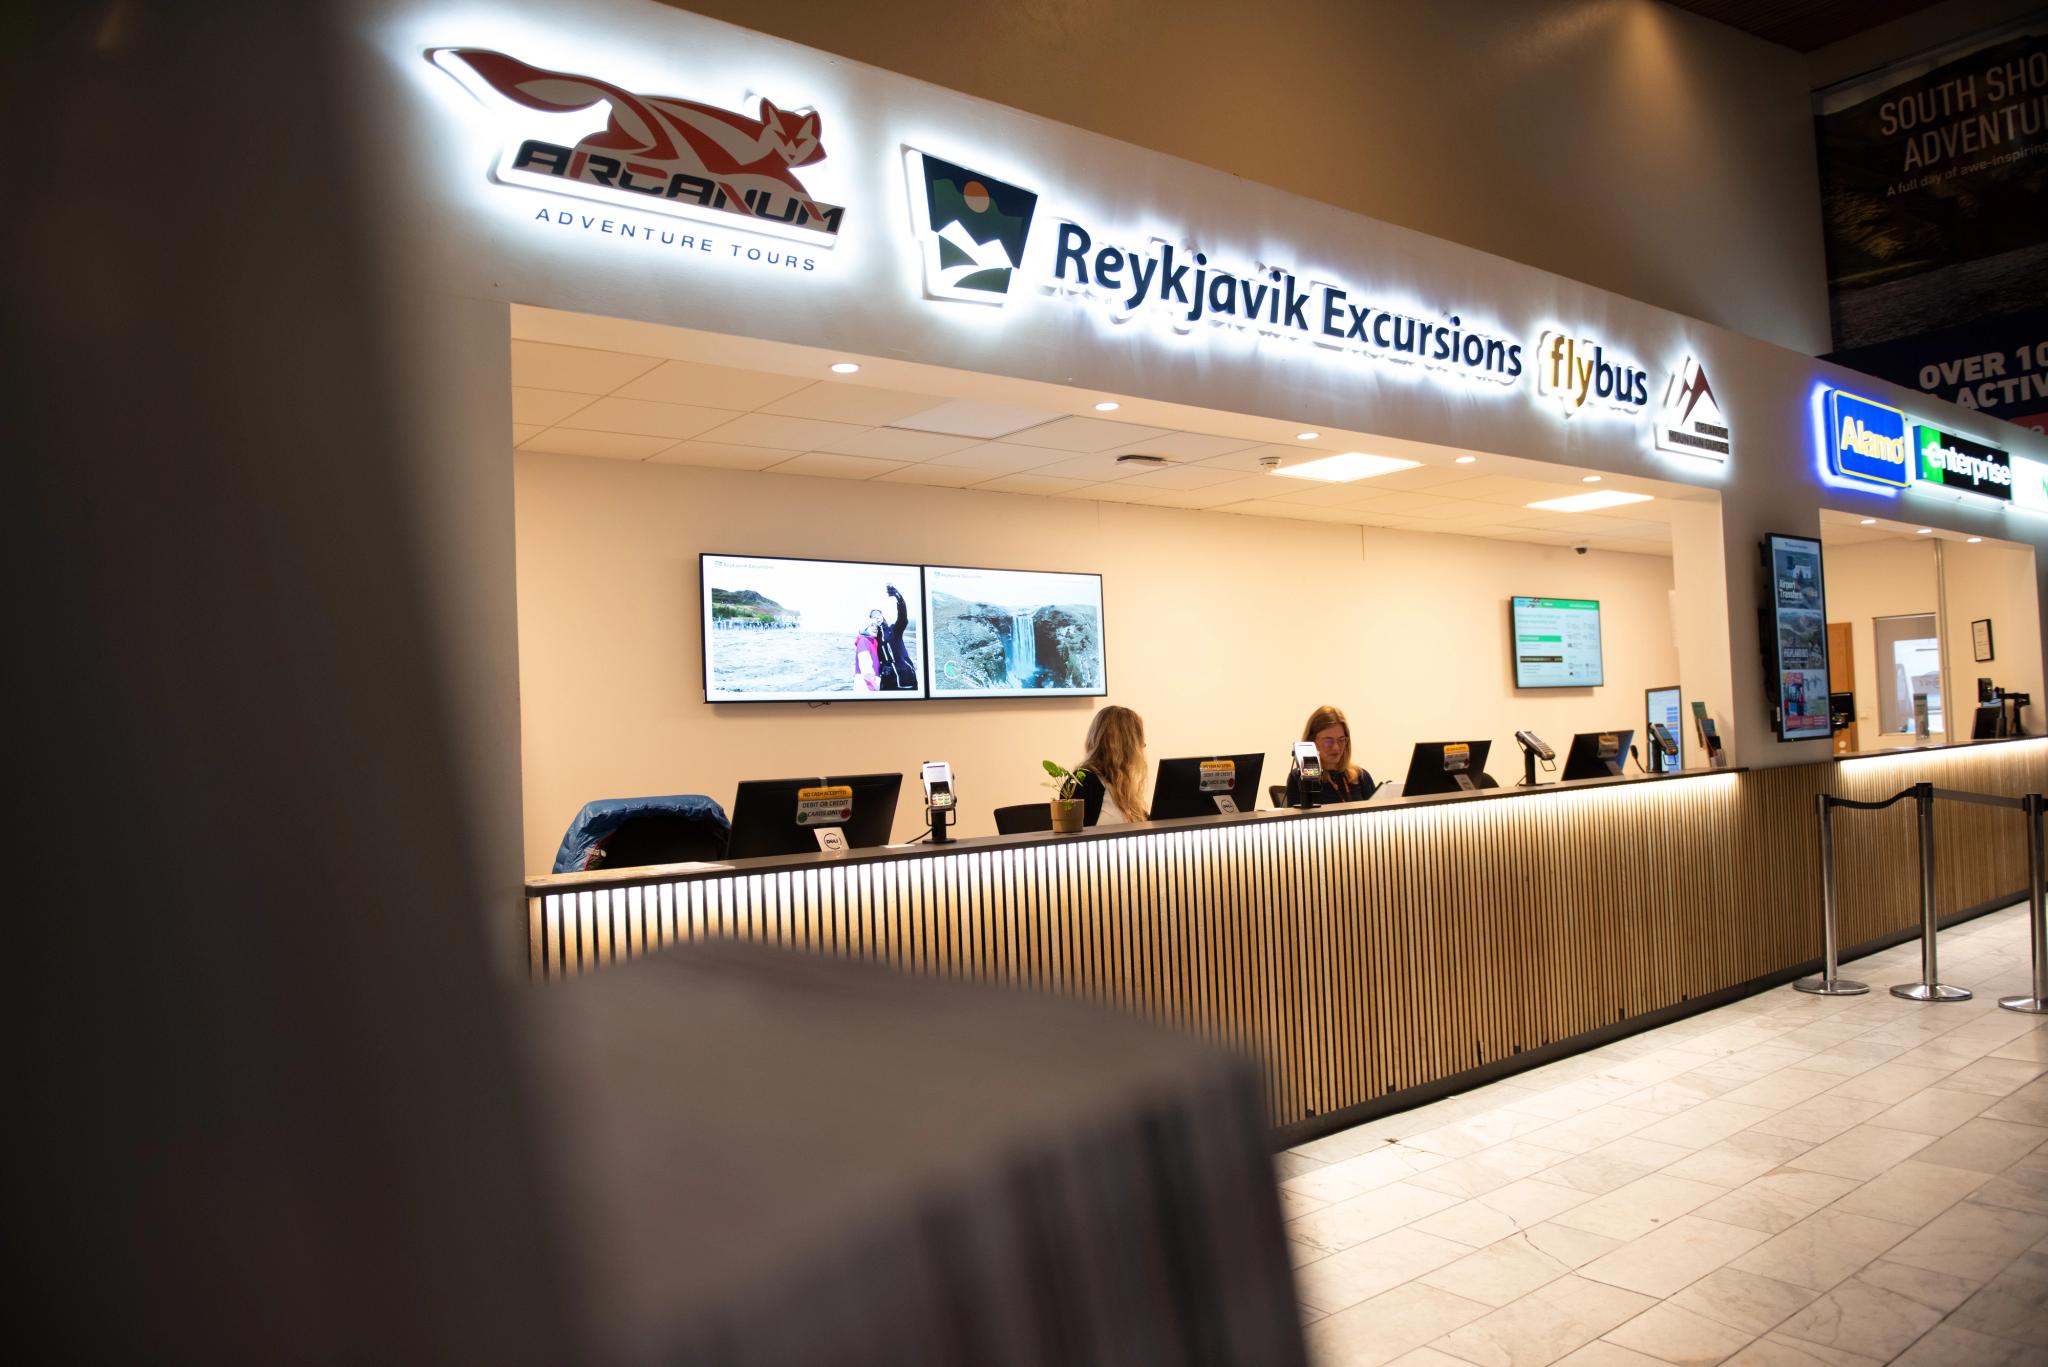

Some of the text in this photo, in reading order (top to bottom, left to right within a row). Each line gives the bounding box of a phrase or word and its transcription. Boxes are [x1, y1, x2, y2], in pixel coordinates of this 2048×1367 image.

[1880, 74, 1977, 136] SOUTH
[1904, 95, 2048, 172] ADVENTU
[512, 140, 846, 234] ARCANUM
[1886, 186, 1896, 198] A
[1898, 178, 1918, 194] full
[1920, 172, 1942, 187] day
[1945, 166, 1958, 180] of
[535, 208, 816, 271] ADVENTURE TOURS
[1054, 222, 1523, 377] Reykjavik Excursions
[1551, 335, 1648, 408] flybus
[1919, 351, 2007, 390] OVER
[1841, 416, 1904, 465] Alamo
[1922, 441, 2012, 486] enterprise
